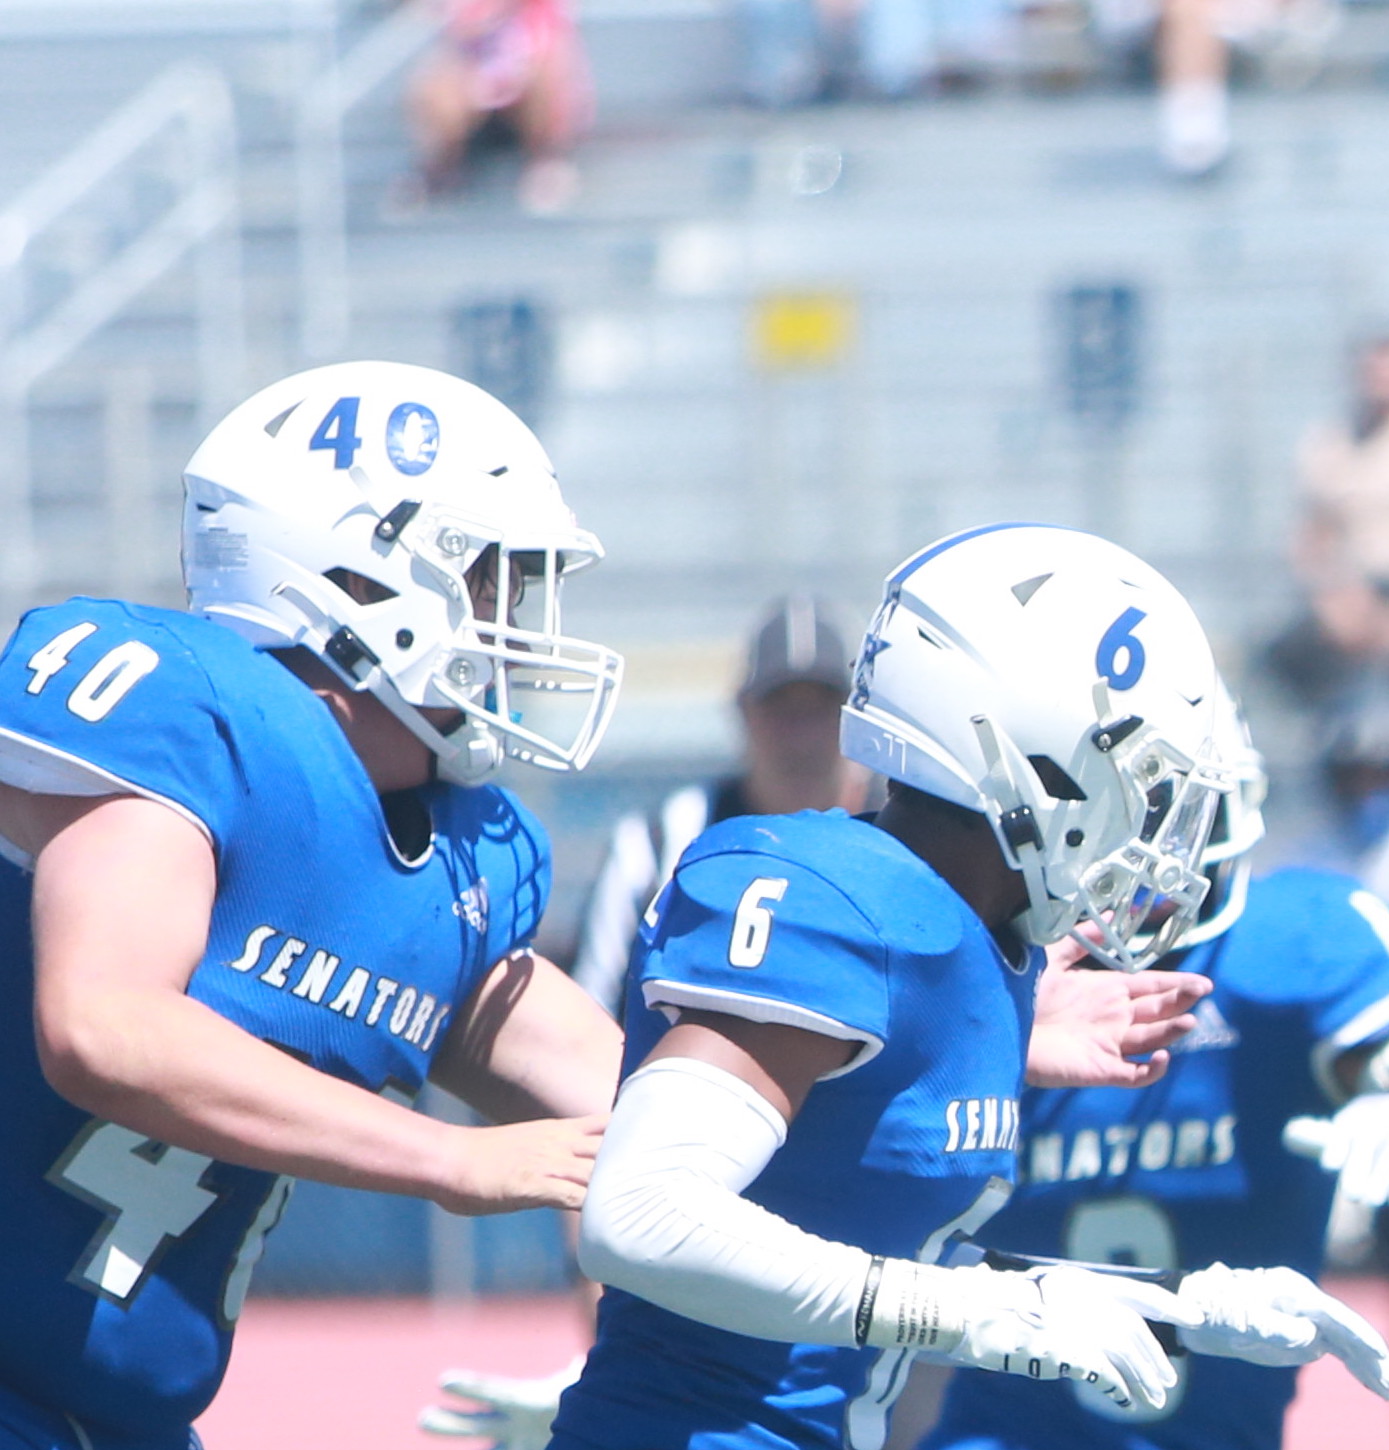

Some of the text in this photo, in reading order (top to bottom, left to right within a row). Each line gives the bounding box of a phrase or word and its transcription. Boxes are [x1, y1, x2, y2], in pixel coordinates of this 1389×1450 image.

[308, 396, 440, 476] 40
[23, 621, 159, 722] 40
[1096, 606, 1147, 691] 6
[728, 877, 788, 968] 6
